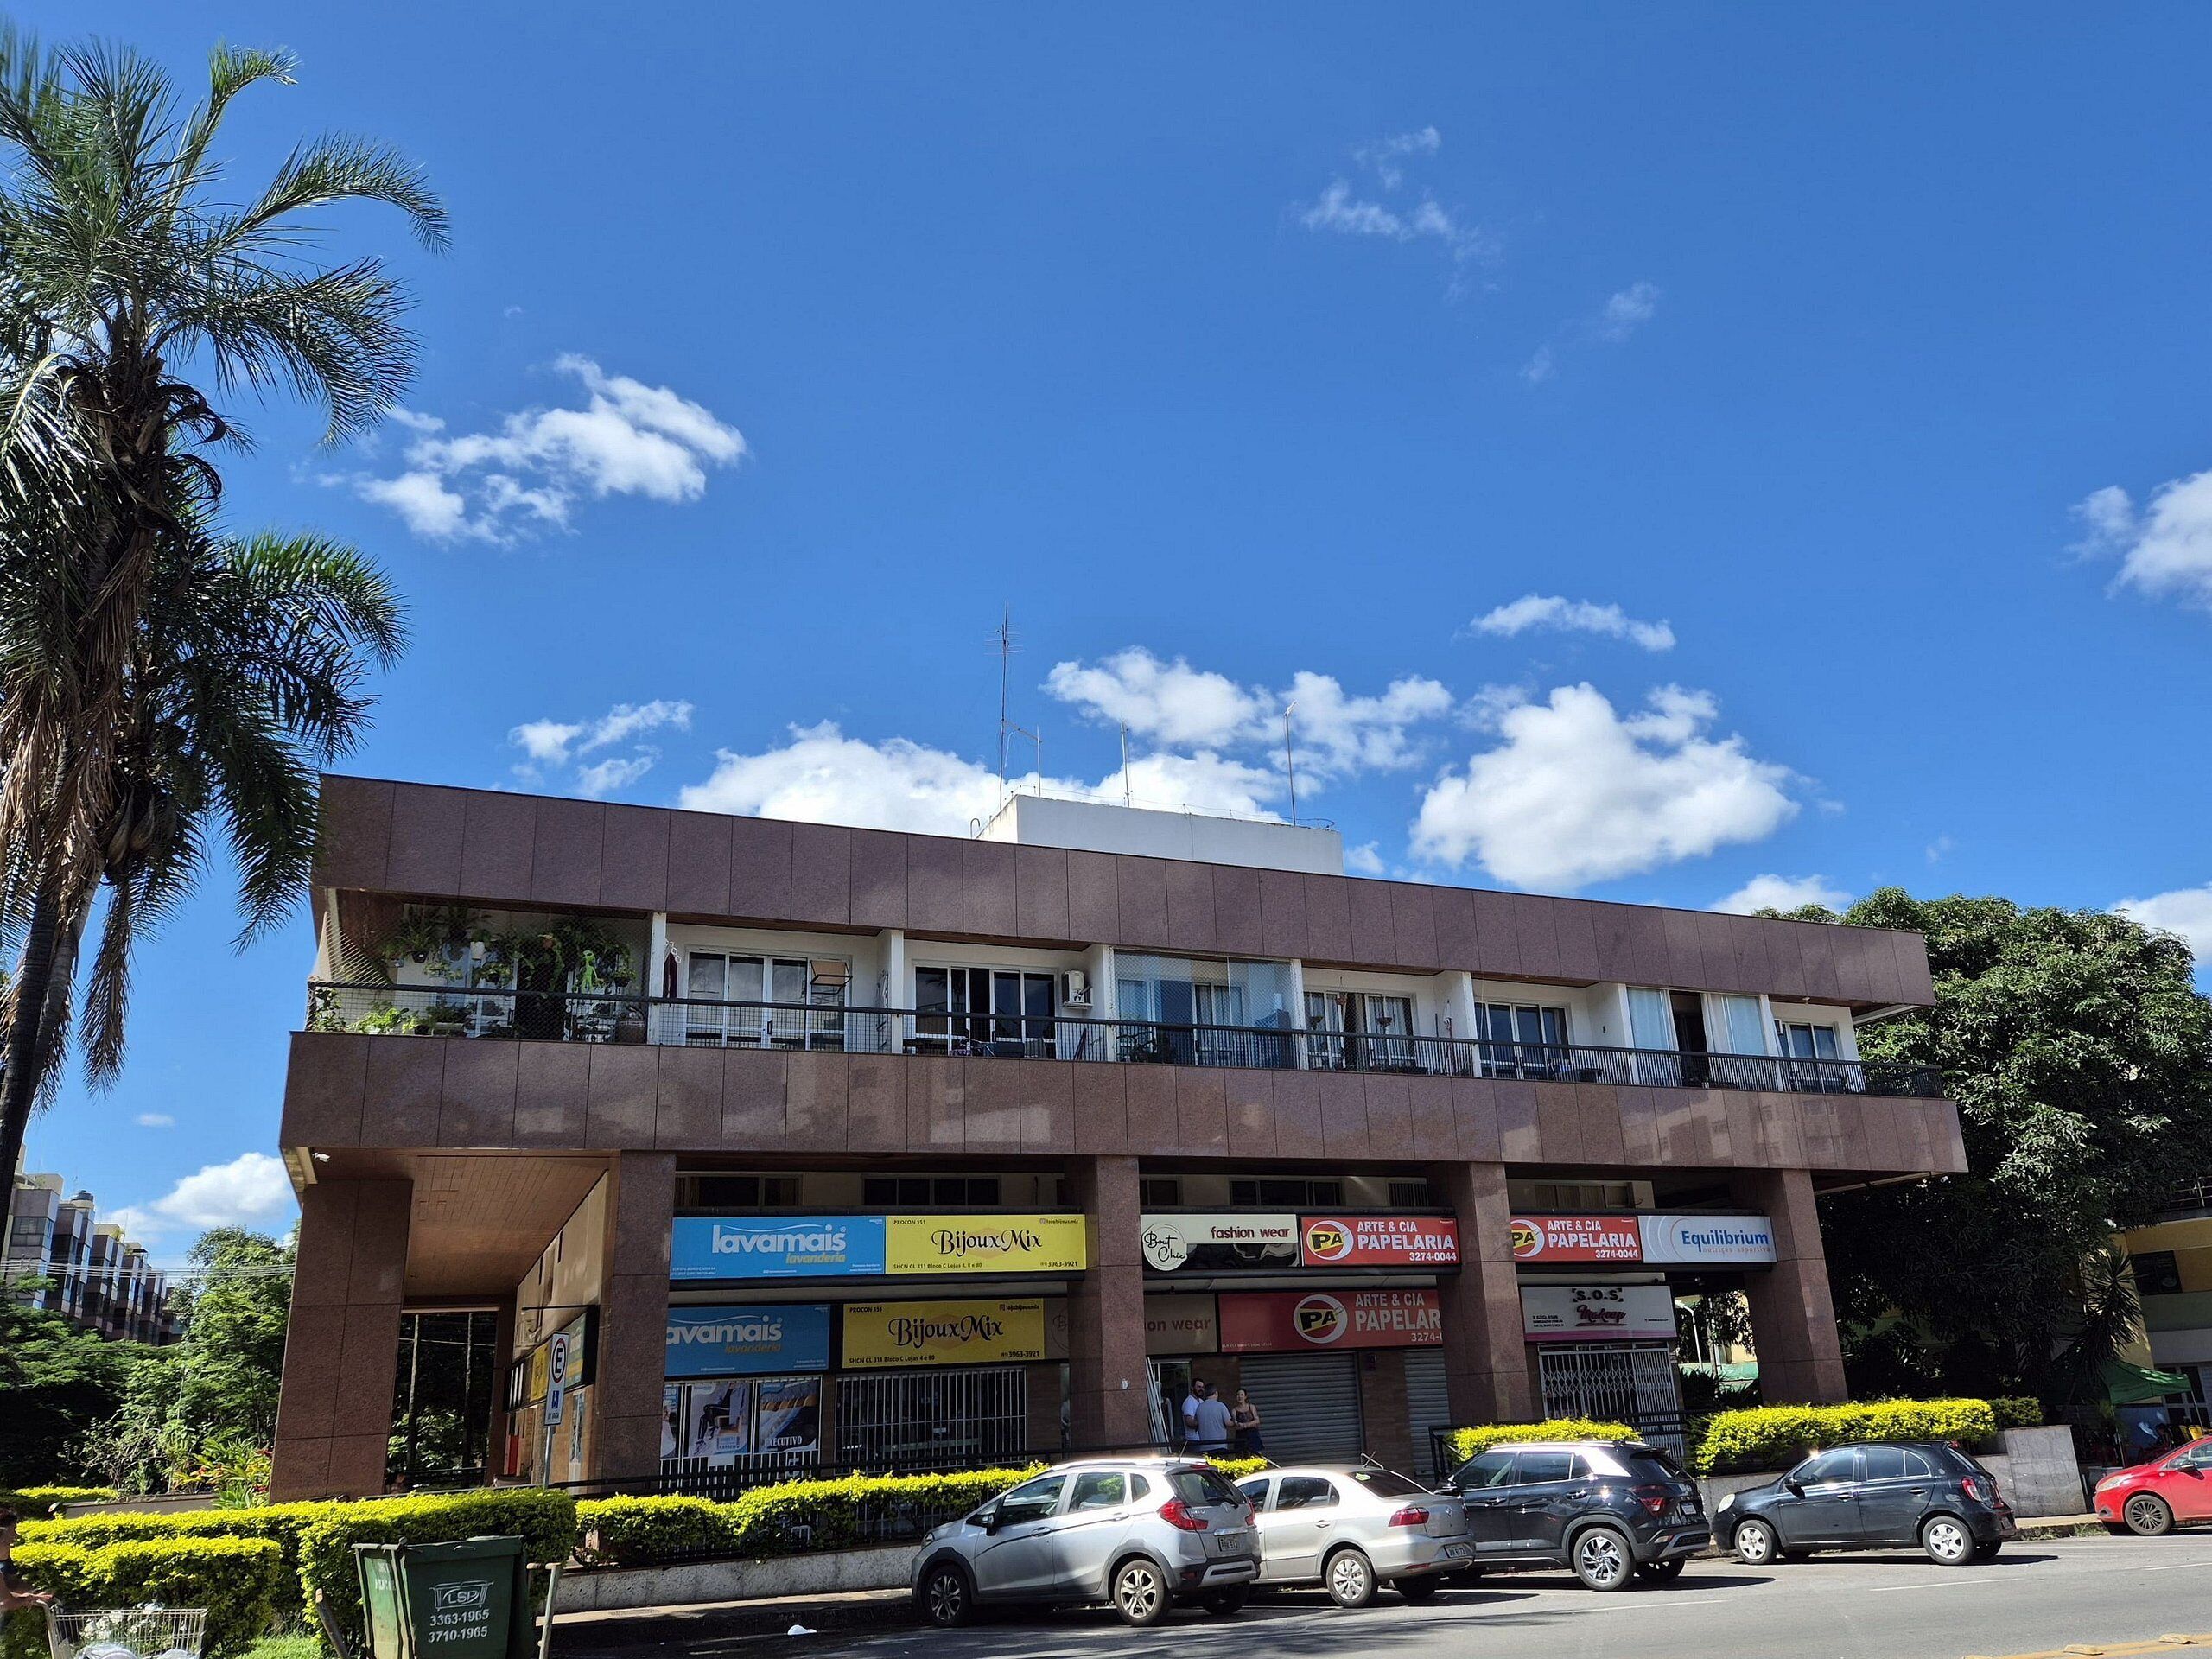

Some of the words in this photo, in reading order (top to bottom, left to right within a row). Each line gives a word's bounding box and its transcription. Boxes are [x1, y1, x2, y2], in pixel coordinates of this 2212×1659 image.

[1211, 1225, 1255, 1239] fashion
[1260, 1227, 1290, 1238] wear
[1357, 1221, 1385, 1233] ARTE
[1389, 1220, 1396, 1232] &
[1399, 1220, 1418, 1232] CIA
[1547, 1220, 1573, 1231] ARTE
[1575, 1220, 1583, 1231] &
[1585, 1220, 1602, 1231] CIA
[712, 1224, 847, 1253] lavamais
[1311, 1233, 1343, 1250] PA
[1357, 1234, 1455, 1250] PAPELARIA
[1548, 1233, 1637, 1248] PAPELARIA
[1681, 1230, 1769, 1252] Equilibrium
[785, 1253, 846, 1265] lavanderia
[1409, 1252, 1457, 1262] 3274-0044
[1595, 1249, 1638, 1258] 3274-0044
[1355, 1294, 1388, 1307] ARTE
[1391, 1293, 1401, 1306] &
[1404, 1293, 1425, 1306] CIA
[1172, 1319, 1211, 1330] wear
[1300, 1310, 1336, 1331] PA
[1355, 1308, 1441, 1332] PAPELAR
[1411, 1332, 1443, 1342] 3274-
[725, 1344, 782, 1355] lavanderia
[555, 1348, 563, 1374] E
[765, 1435, 803, 1447] EXECUTIVO
[448, 1590, 479, 1605] LSP
